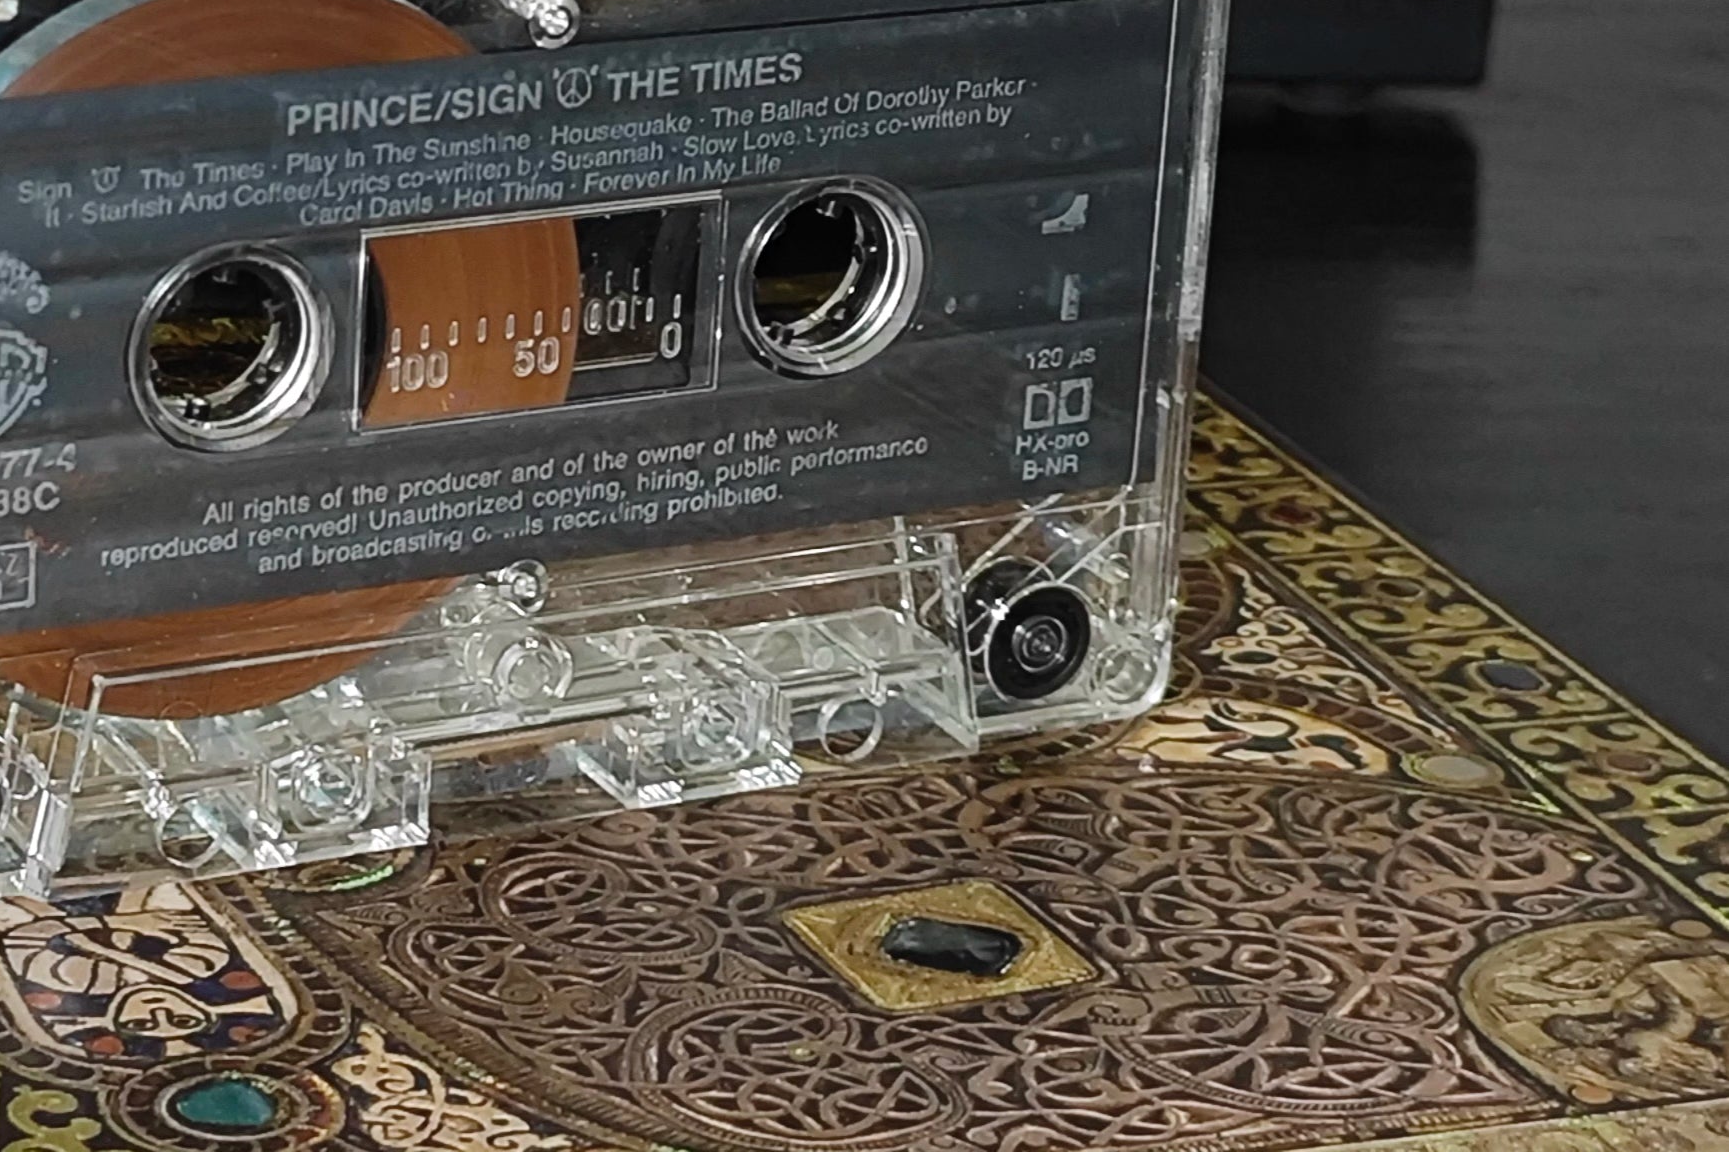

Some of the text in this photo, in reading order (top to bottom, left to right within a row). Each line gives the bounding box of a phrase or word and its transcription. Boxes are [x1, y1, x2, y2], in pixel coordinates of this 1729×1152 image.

[287, 52, 803, 136] PRINCE/SIGN THE TIMES
[19, 179, 72, 205] Sign
[192, 161, 265, 185] Times
[287, 151, 338, 176] Play
[344, 148, 366, 169] In
[373, 143, 416, 166] The
[423, 132, 532, 160] Sunshine
[550, 113, 691, 147] Housequake
[711, 106, 754, 129] The
[760, 95, 828, 125] Ballad
[833, 91, 859, 116] Of
[867, 83, 950, 114] Dorothy
[956, 76, 1027, 101] Parker
[81, 195, 173, 225] Starfish
[179, 188, 228, 214] And
[397, 159, 511, 190] co-written
[551, 142, 663, 173] Susannah
[683, 133, 738, 158] Slow
[875, 106, 982, 136] co-written
[986, 102, 1012, 129] by
[300, 151, 783, 227] Carol Davis Hot Thing Forever In My Life
[385, 321, 682, 393] 100 50 0
[1026, 347, 1063, 371] 120
[101, 528, 238, 569] reproduced
[369, 489, 524, 532] Unauthorized
[532, 479, 628, 511] copying,
[636, 466, 706, 498] hiring,
[714, 454, 781, 489] public
[790, 435, 929, 478] performance
[202, 419, 840, 526] All rights of the producer and of the owner of the work
[1022, 453, 1079, 481] B-NR
[258, 552, 303, 575] and
[310, 527, 464, 568] broadcasting
[666, 483, 783, 520] prohibited.
